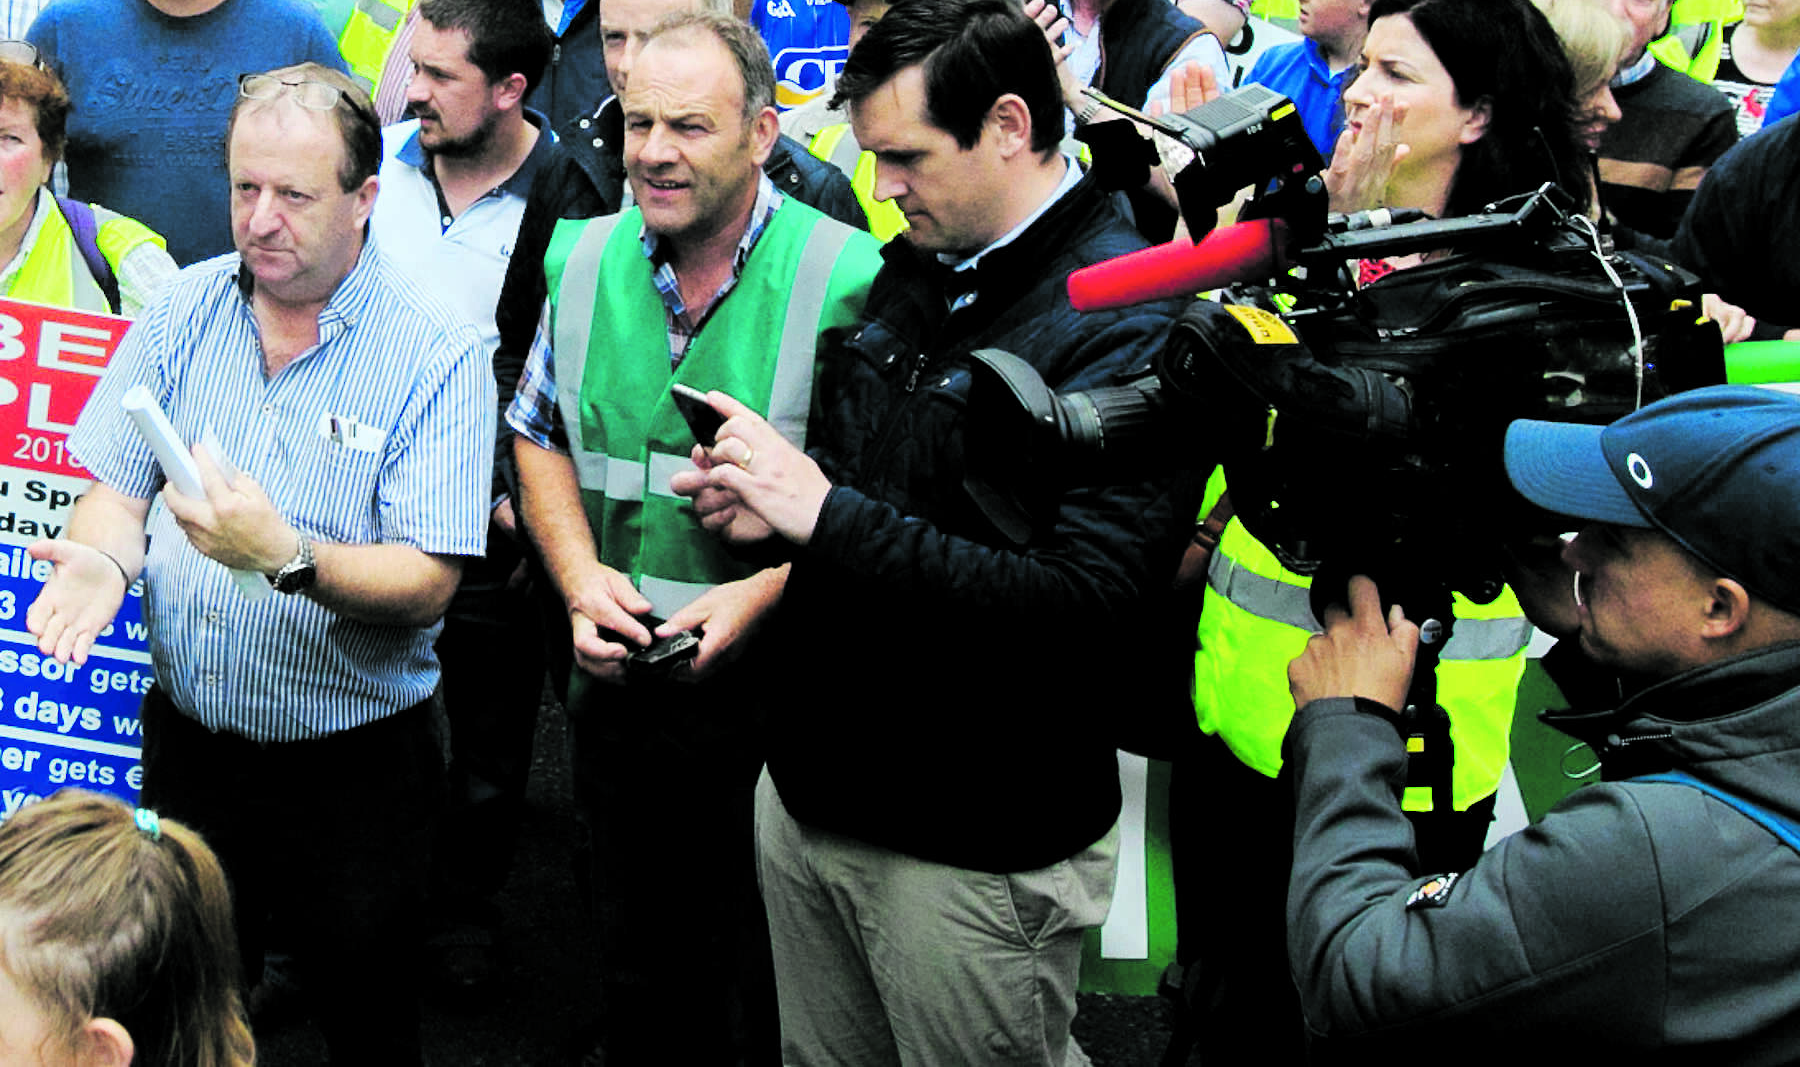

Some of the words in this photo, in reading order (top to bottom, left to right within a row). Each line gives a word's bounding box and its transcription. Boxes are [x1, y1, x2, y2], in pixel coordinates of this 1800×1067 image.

[90, 659, 154, 697] gets
[14, 689, 102, 733] days
[48, 756, 114, 786] gets
